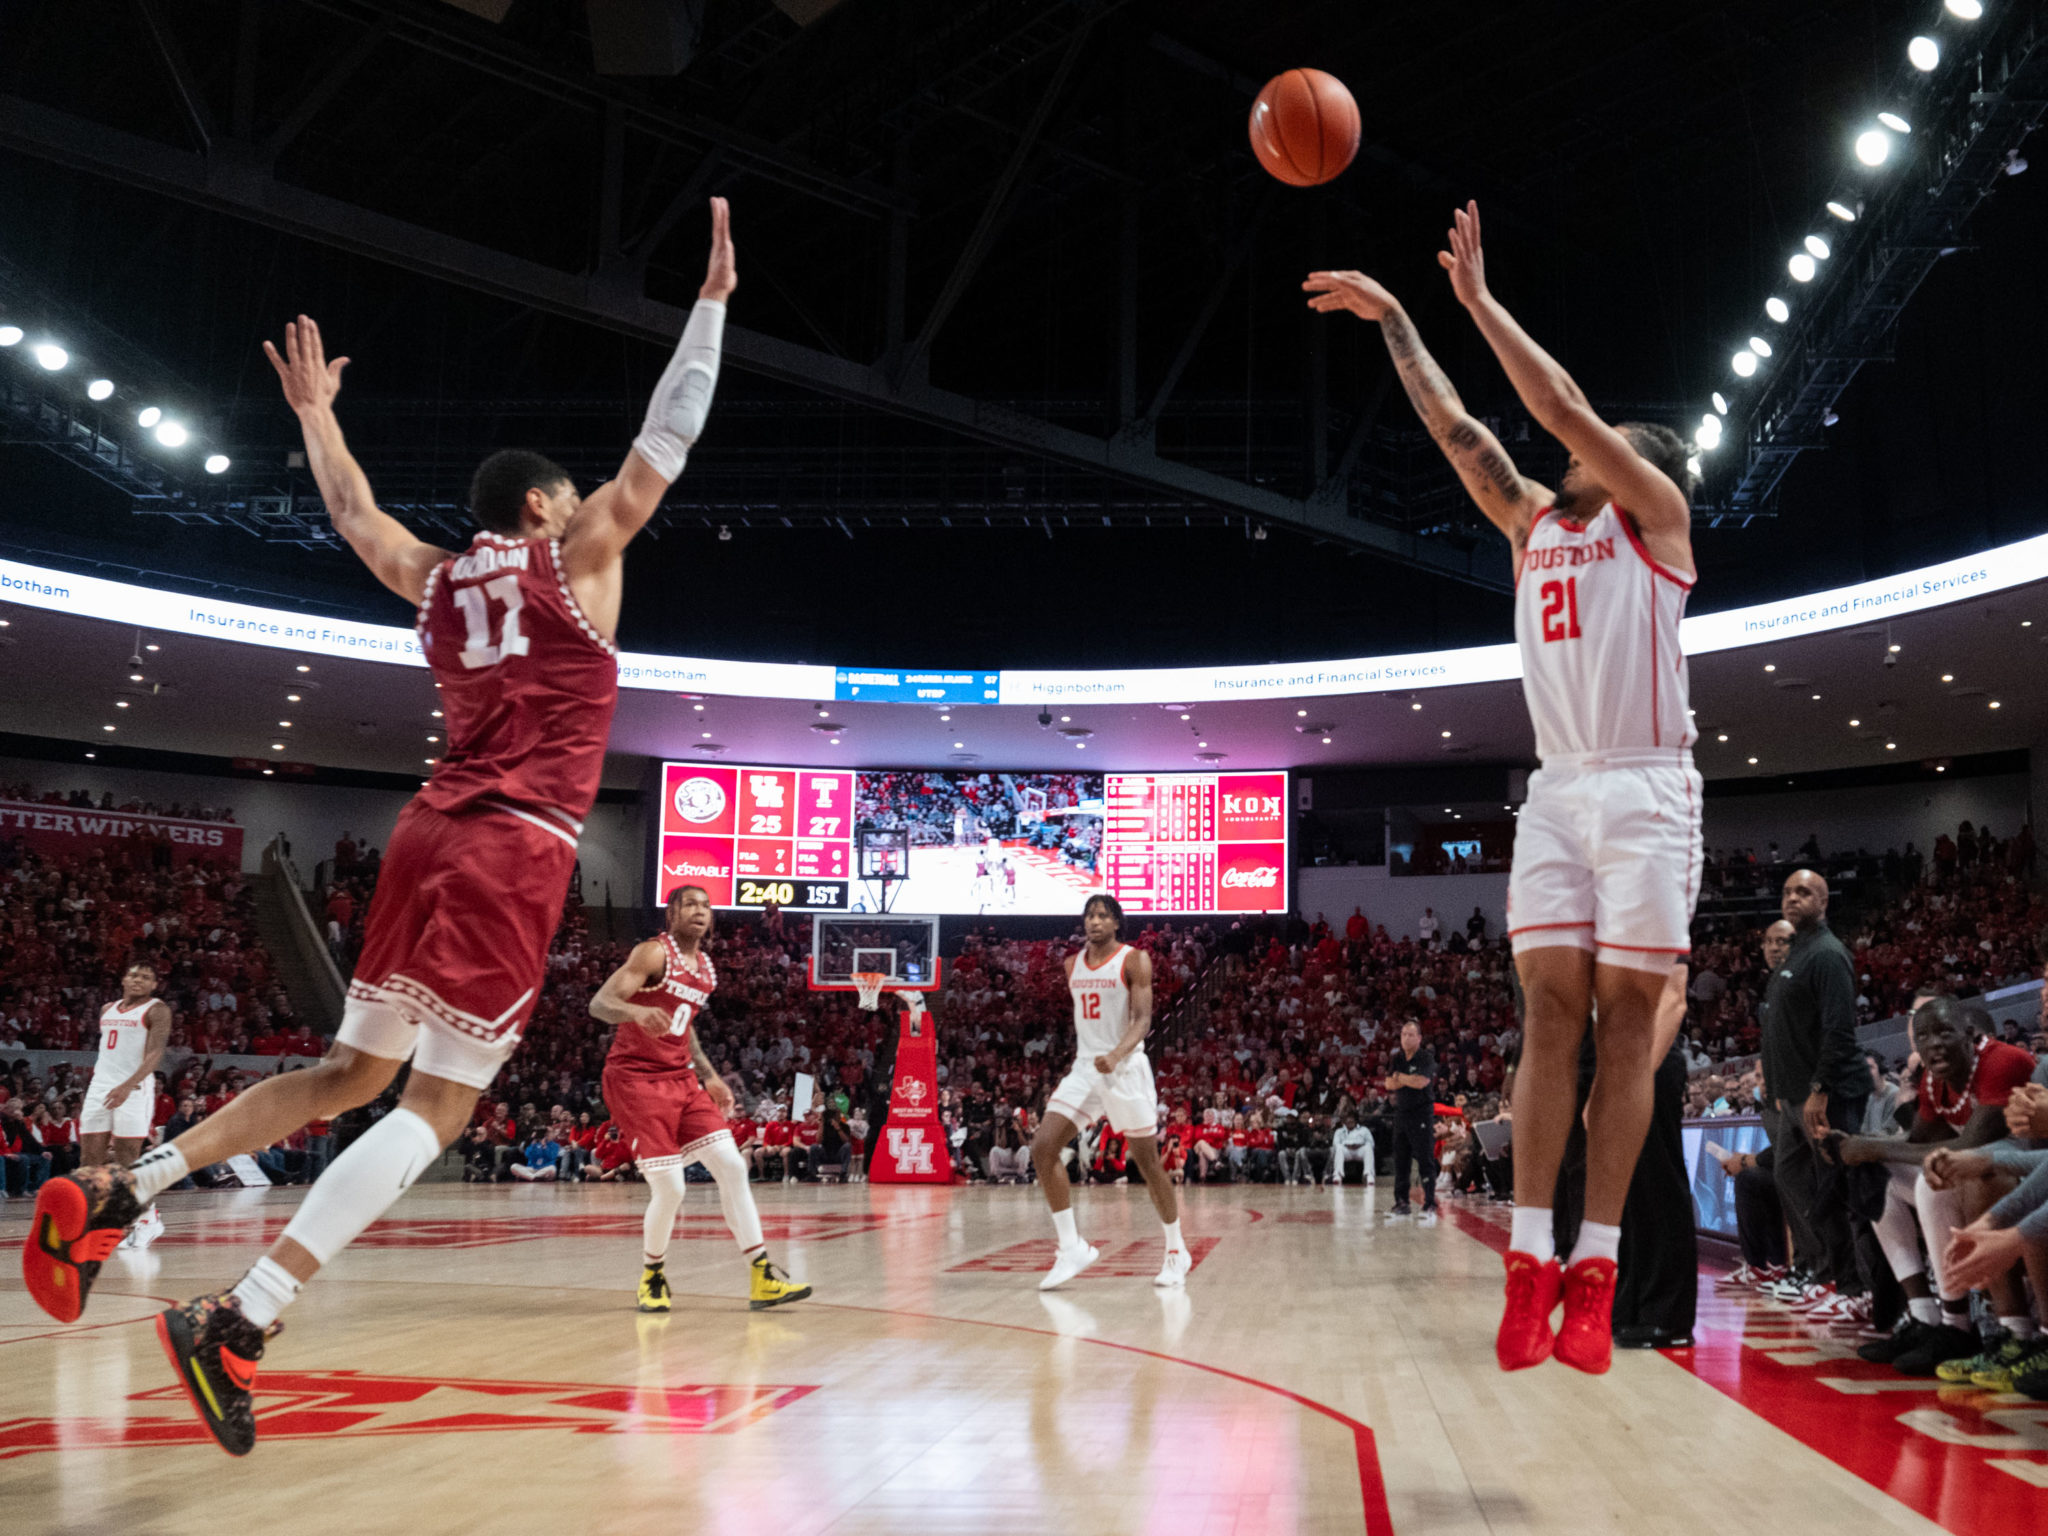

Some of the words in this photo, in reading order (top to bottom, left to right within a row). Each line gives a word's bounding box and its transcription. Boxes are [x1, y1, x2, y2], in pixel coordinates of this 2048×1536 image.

[1527, 537, 1616, 572] OUSTON
[1541, 576, 1582, 643] 21
[1744, 609, 1817, 632] Insurance
[1821, 601, 1849, 618] and
[1853, 584, 1919, 611] Financial
[1922, 568, 1989, 595] Services
[189, 608, 280, 635] Insurance
[285, 623, 317, 641] and
[322, 630, 400, 652] Financial
[453, 574, 531, 669] 11
[618, 664, 708, 681] igginbotham
[1214, 677, 1285, 689] Insurance
[1288, 675, 1314, 686] and
[1318, 669, 1382, 684] Financial
[1385, 664, 1447, 678] Services
[1032, 681, 1126, 695] Higginbotham
[750, 815, 782, 834] 25
[809, 817, 841, 836] 27
[776, 849, 784, 859] 7
[776, 863, 785, 873] 4
[832, 864, 841, 874] 4
[739, 881, 794, 905] 2:40
[807, 885, 840, 905] 1ST
[665, 979, 709, 1006] TEMPL
[1081, 992, 1101, 1020] 12
[669, 1003, 692, 1037] 0
[106, 1029, 118, 1050] 0
[886, 1127, 934, 1175] UH
